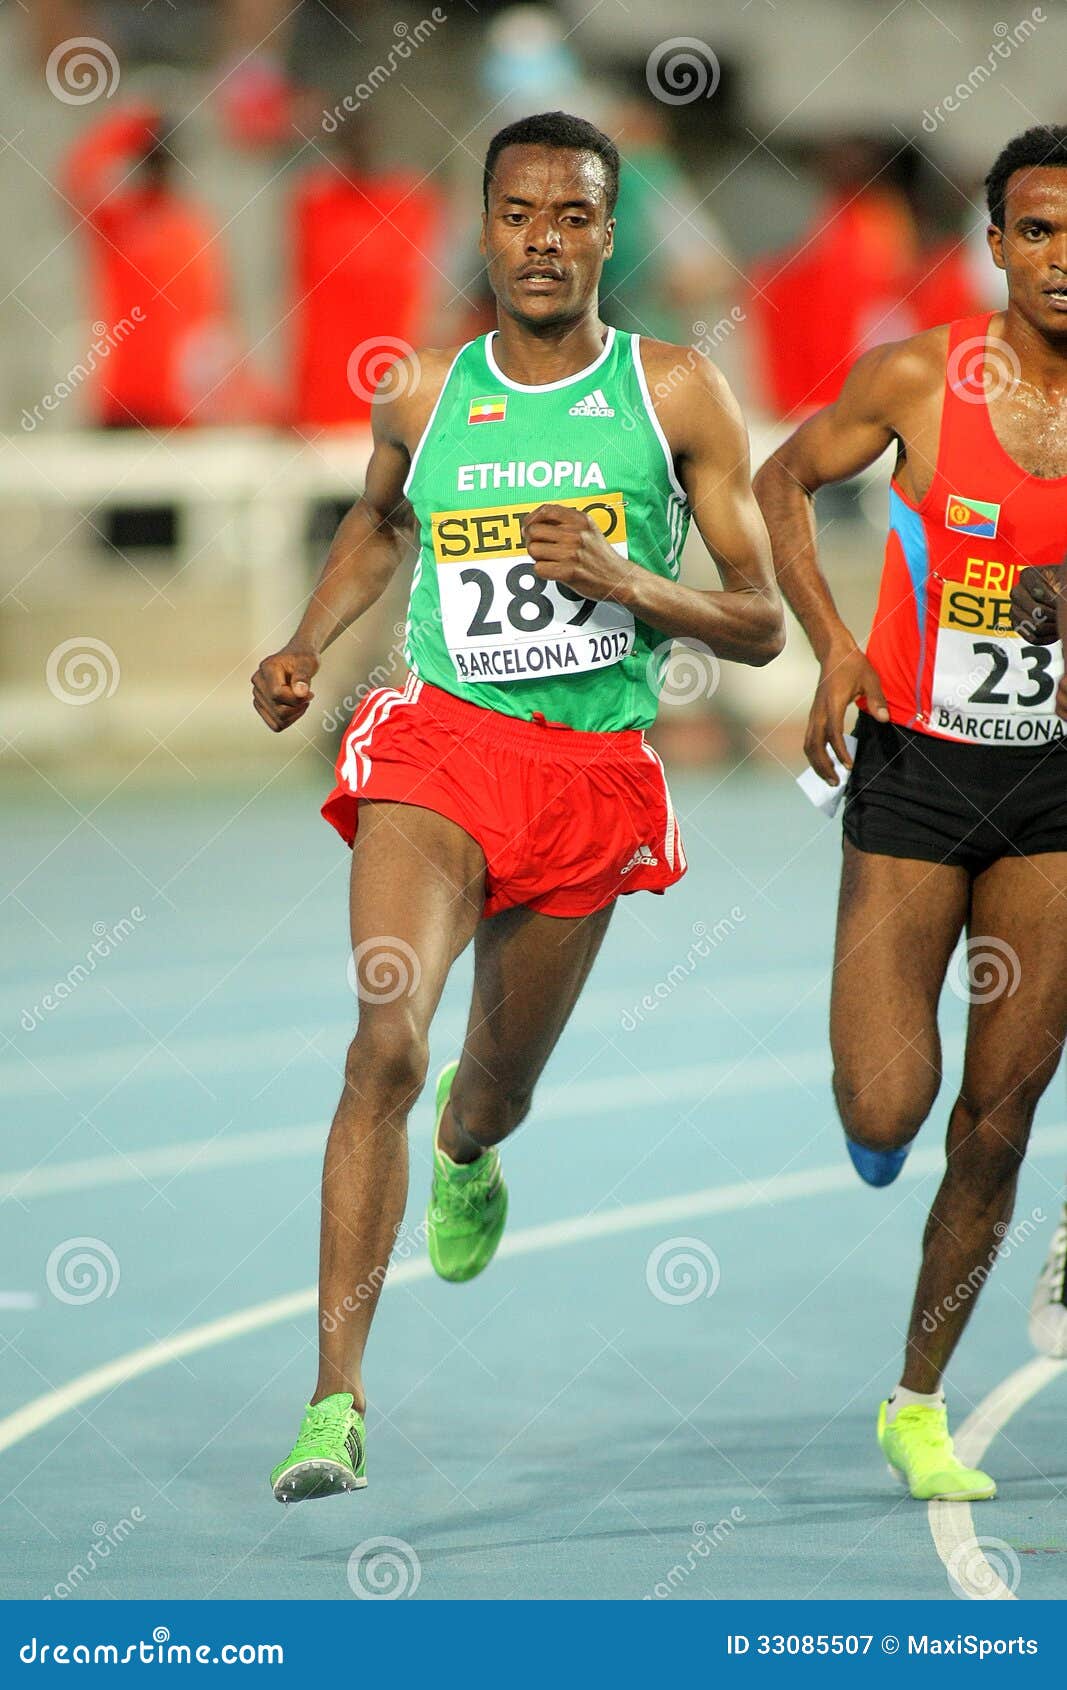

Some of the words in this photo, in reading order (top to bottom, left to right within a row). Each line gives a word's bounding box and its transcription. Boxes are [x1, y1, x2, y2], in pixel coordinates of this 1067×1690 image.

[568, 403, 616, 418] adidas
[457, 461, 606, 491] ETHIOPIA
[437, 502, 618, 557] SEIO
[456, 642, 580, 677] BARCELONA
[589, 632, 629, 664] 2012
[968, 641, 1055, 707] 23
[938, 709, 1065, 741] BARCELONA
